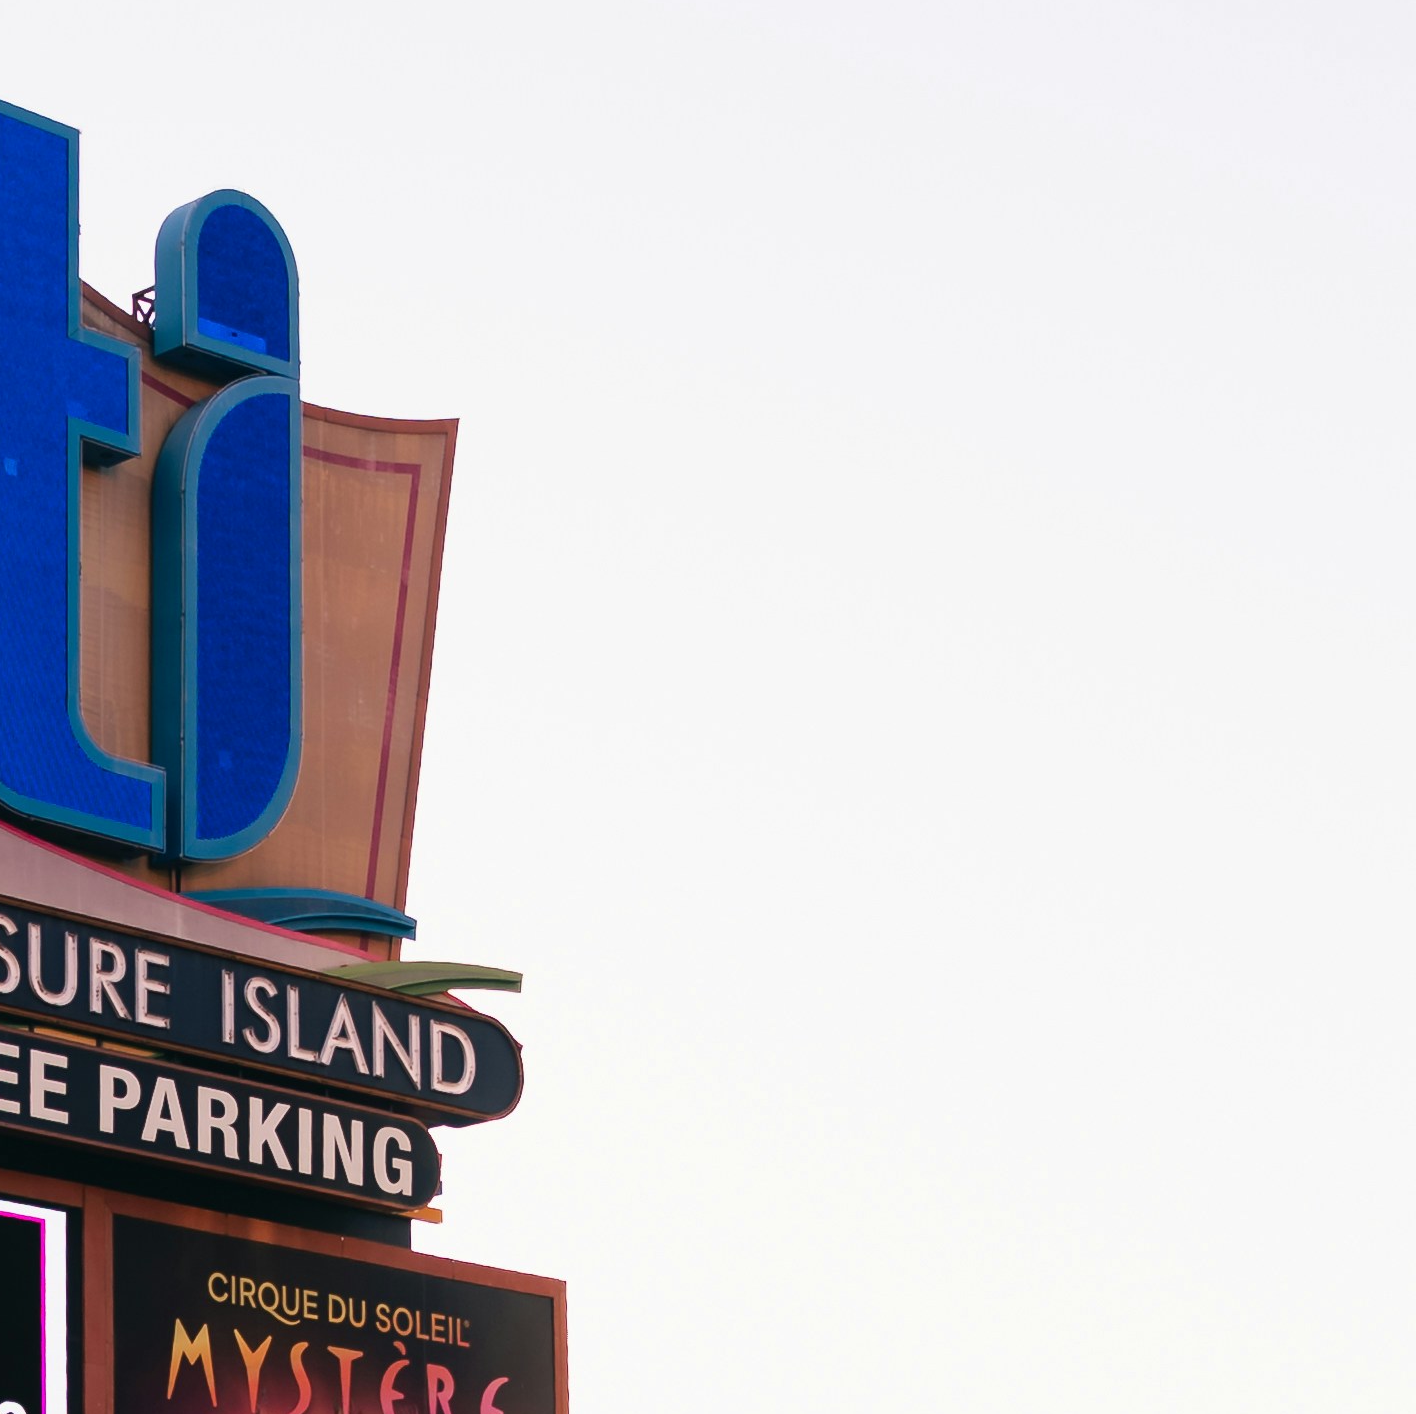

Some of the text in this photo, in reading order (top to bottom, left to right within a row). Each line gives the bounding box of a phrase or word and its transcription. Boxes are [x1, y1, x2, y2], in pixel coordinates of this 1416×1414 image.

[220, 970, 477, 1095] ISLAND
[99, 1064, 414, 1198] PARKING
[208, 1272, 319, 1326] CIRQUE
[328, 1294, 366, 1328] DU
